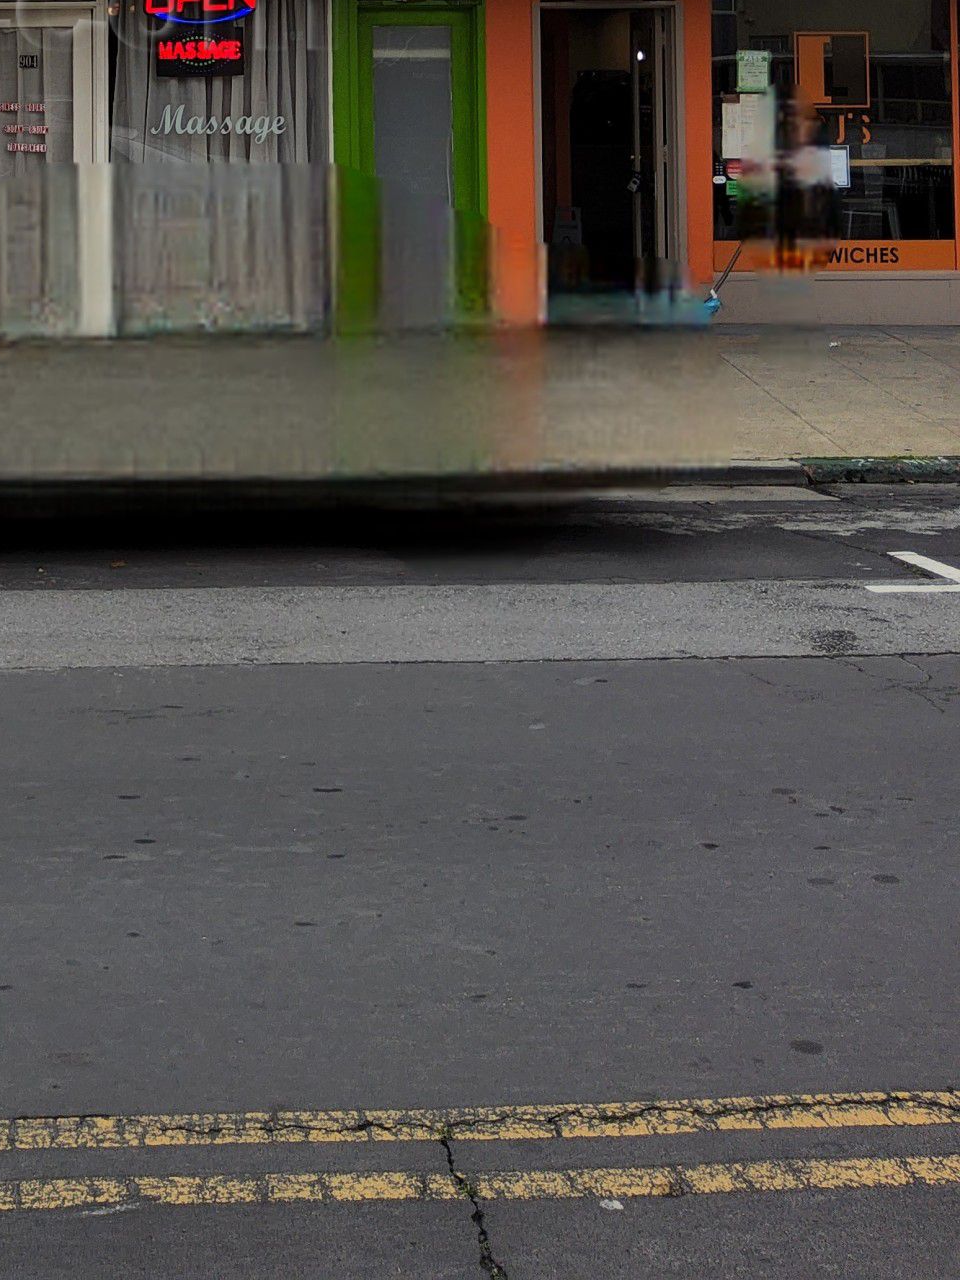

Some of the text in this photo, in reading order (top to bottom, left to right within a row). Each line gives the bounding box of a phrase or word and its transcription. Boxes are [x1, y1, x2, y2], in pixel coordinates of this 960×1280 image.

[159, 40, 242, 59] MASSAGE
[19, 54, 38, 69] 904
[150, 104, 287, 144] Massage
